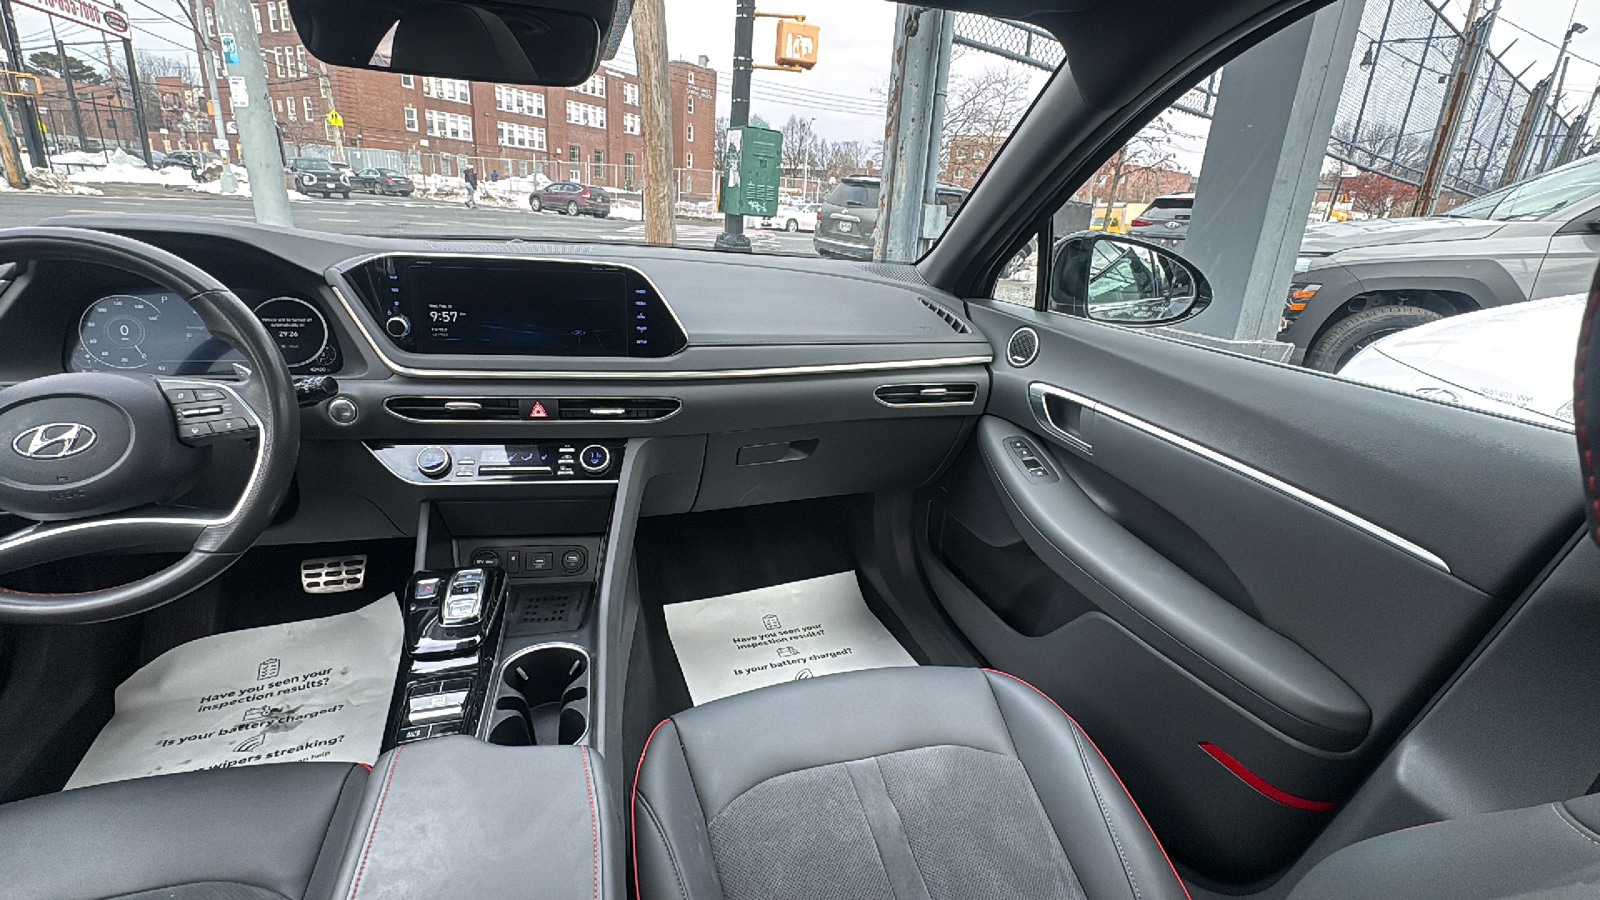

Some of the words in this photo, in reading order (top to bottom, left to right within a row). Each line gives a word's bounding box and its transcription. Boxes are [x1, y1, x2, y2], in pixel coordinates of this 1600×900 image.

[430, 312, 457, 322] 9:57
[120, 325, 129, 335] 0
[733, 635, 757, 644] Have
[758, 632, 777, 641] you
[779, 628, 800, 636] seen
[801, 624, 822, 632] your
[737, 637, 788, 650] inspection
[790, 629, 825, 641] results?
[745, 665, 768, 675] your
[770, 657, 807, 669] battery
[809, 647, 853, 661] charged?
[198, 691, 274, 712] inspection
[277, 677, 330, 696] results?
[200, 690, 236, 704] Have
[238, 684, 265, 696] you
[268, 676, 299, 689] seen
[303, 668, 333, 681] your
[162, 738, 176, 747] Is
[178, 731, 215, 745] your
[218, 719, 275, 736] battery
[278, 704, 344, 724] charged?
[209, 753, 262, 769] wipers
[265, 735, 346, 758] streaking?
[311, 750, 331, 761] help
